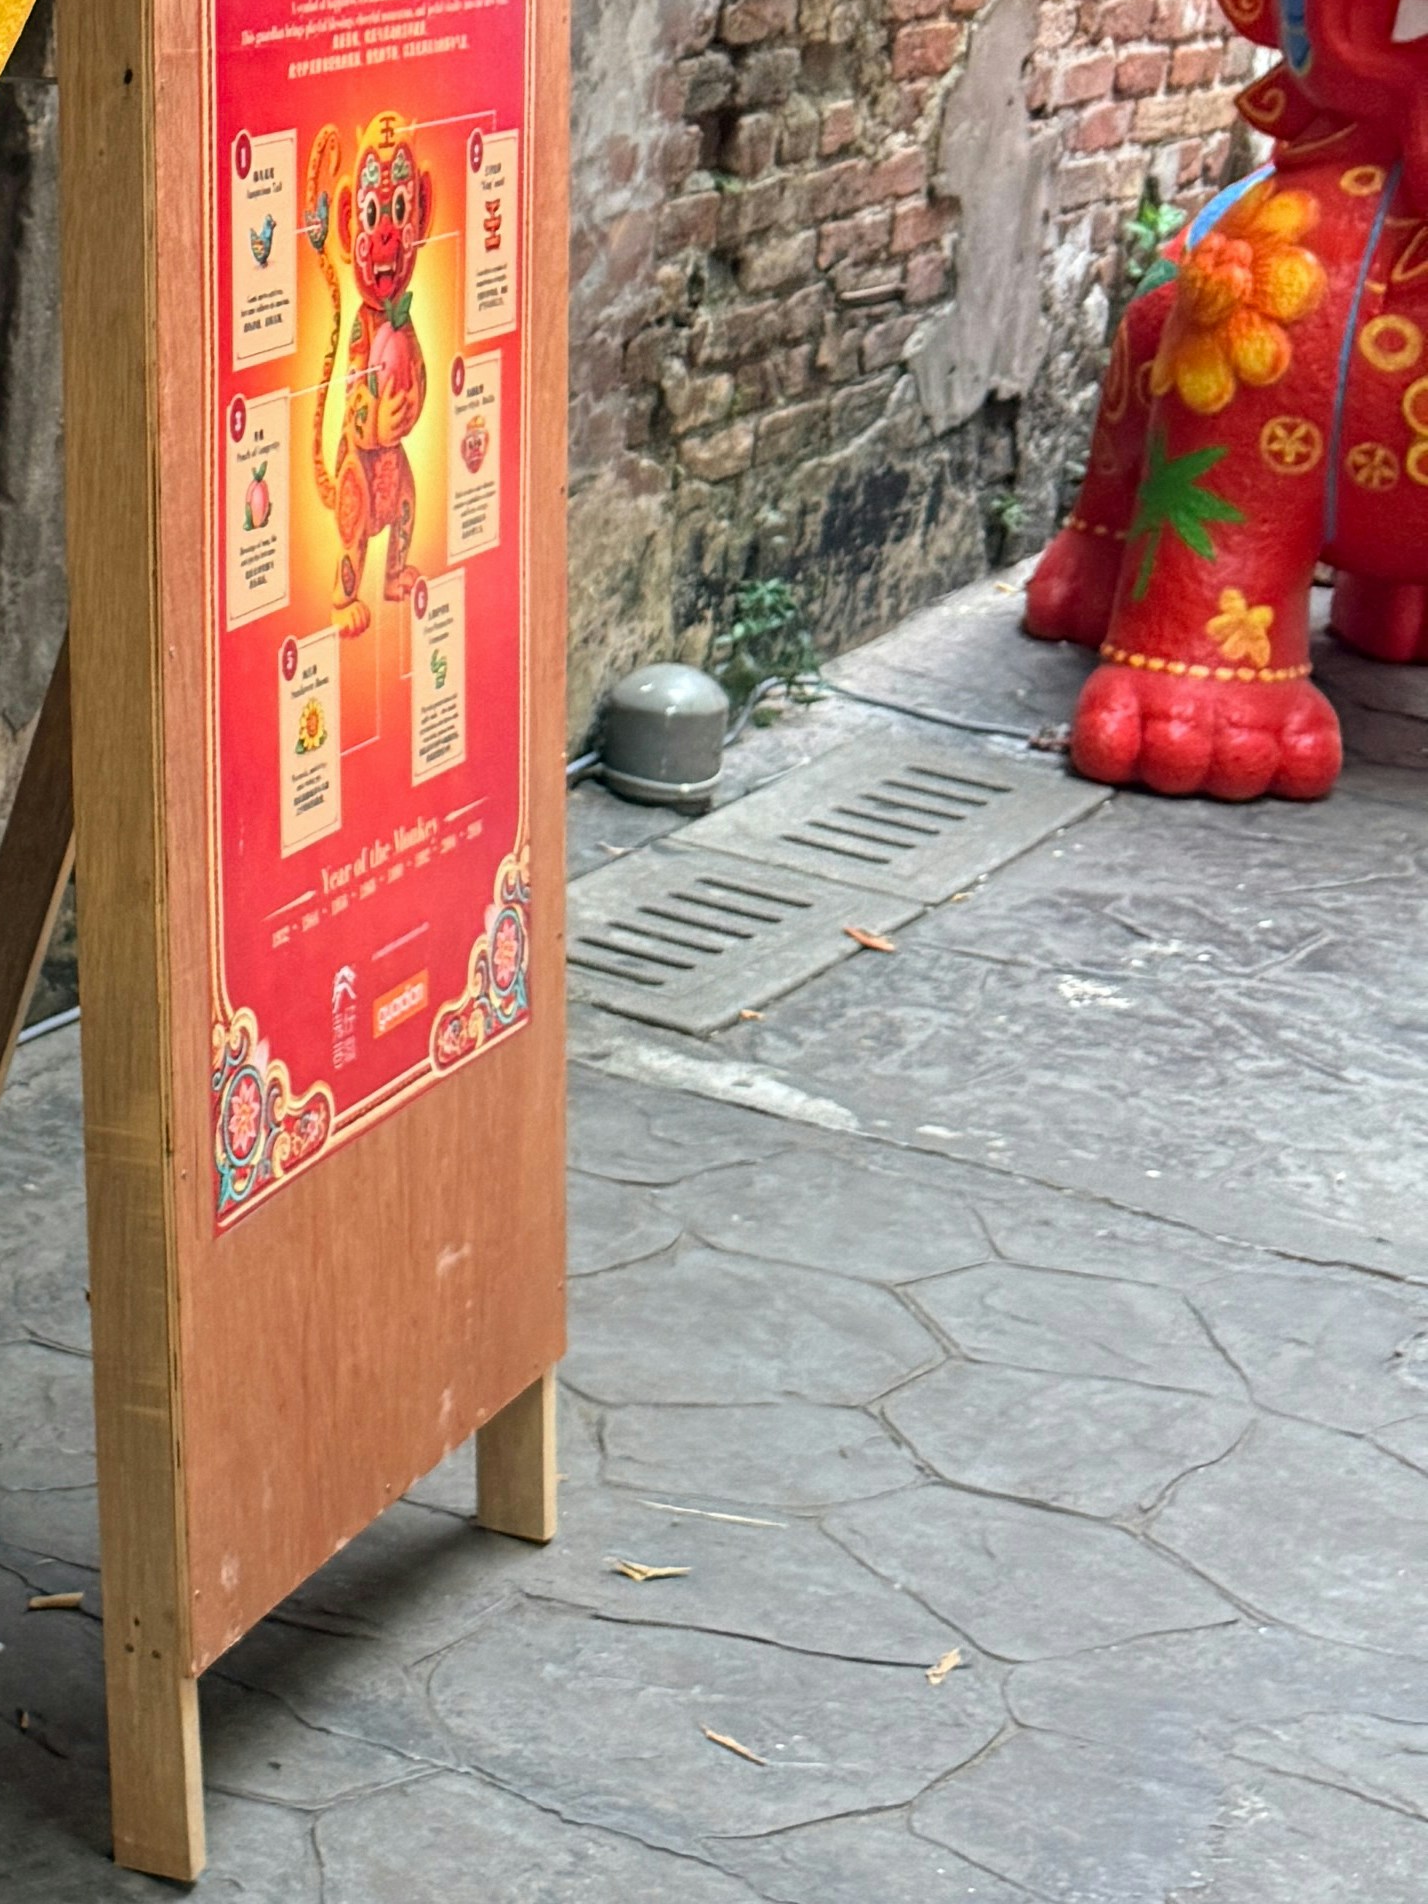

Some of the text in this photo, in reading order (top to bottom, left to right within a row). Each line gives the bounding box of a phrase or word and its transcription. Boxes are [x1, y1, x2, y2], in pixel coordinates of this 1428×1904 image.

[321, 863, 352, 895] Year
[353, 846, 368, 878] of
[370, 838, 391, 869] the
[392, 815, 438, 855] Monkey
